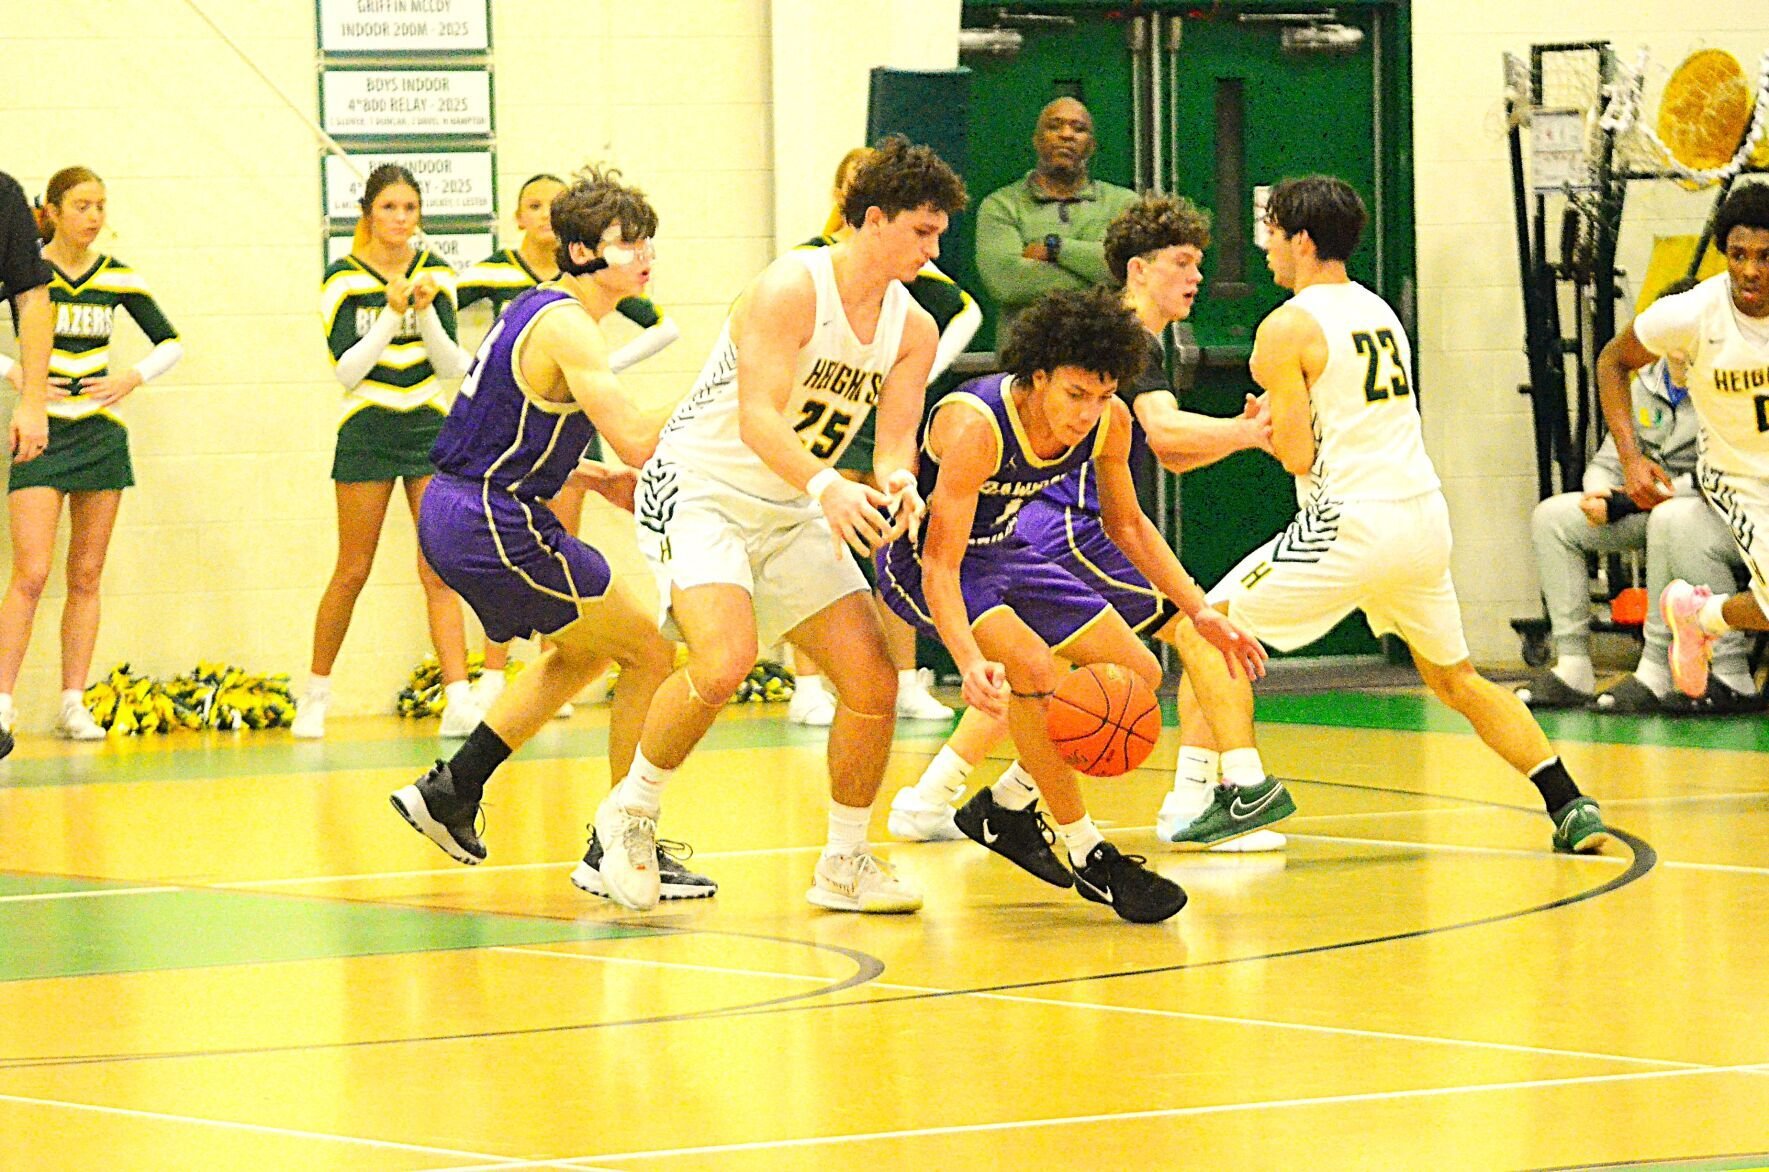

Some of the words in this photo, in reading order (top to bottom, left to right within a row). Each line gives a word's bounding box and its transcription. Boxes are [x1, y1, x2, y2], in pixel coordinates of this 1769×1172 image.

[357, 0, 406, 13] GRIFFIN
[341, 22, 390, 37] INDOOR
[393, 22, 428, 37] 200M
[438, 21, 469, 36] 2025
[366, 77, 398, 92] BOYS
[402, 77, 450, 92] INDOOR
[390, 97, 427, 112] RELAY
[438, 97, 468, 112] 2025
[441, 178, 472, 194] 2025
[54, 302, 114, 337] AZERS
[1351, 328, 1410, 403] 23
[1713, 367, 1769, 392] HEIG
[793, 399, 852, 459] 25
[1240, 561, 1273, 590] H
